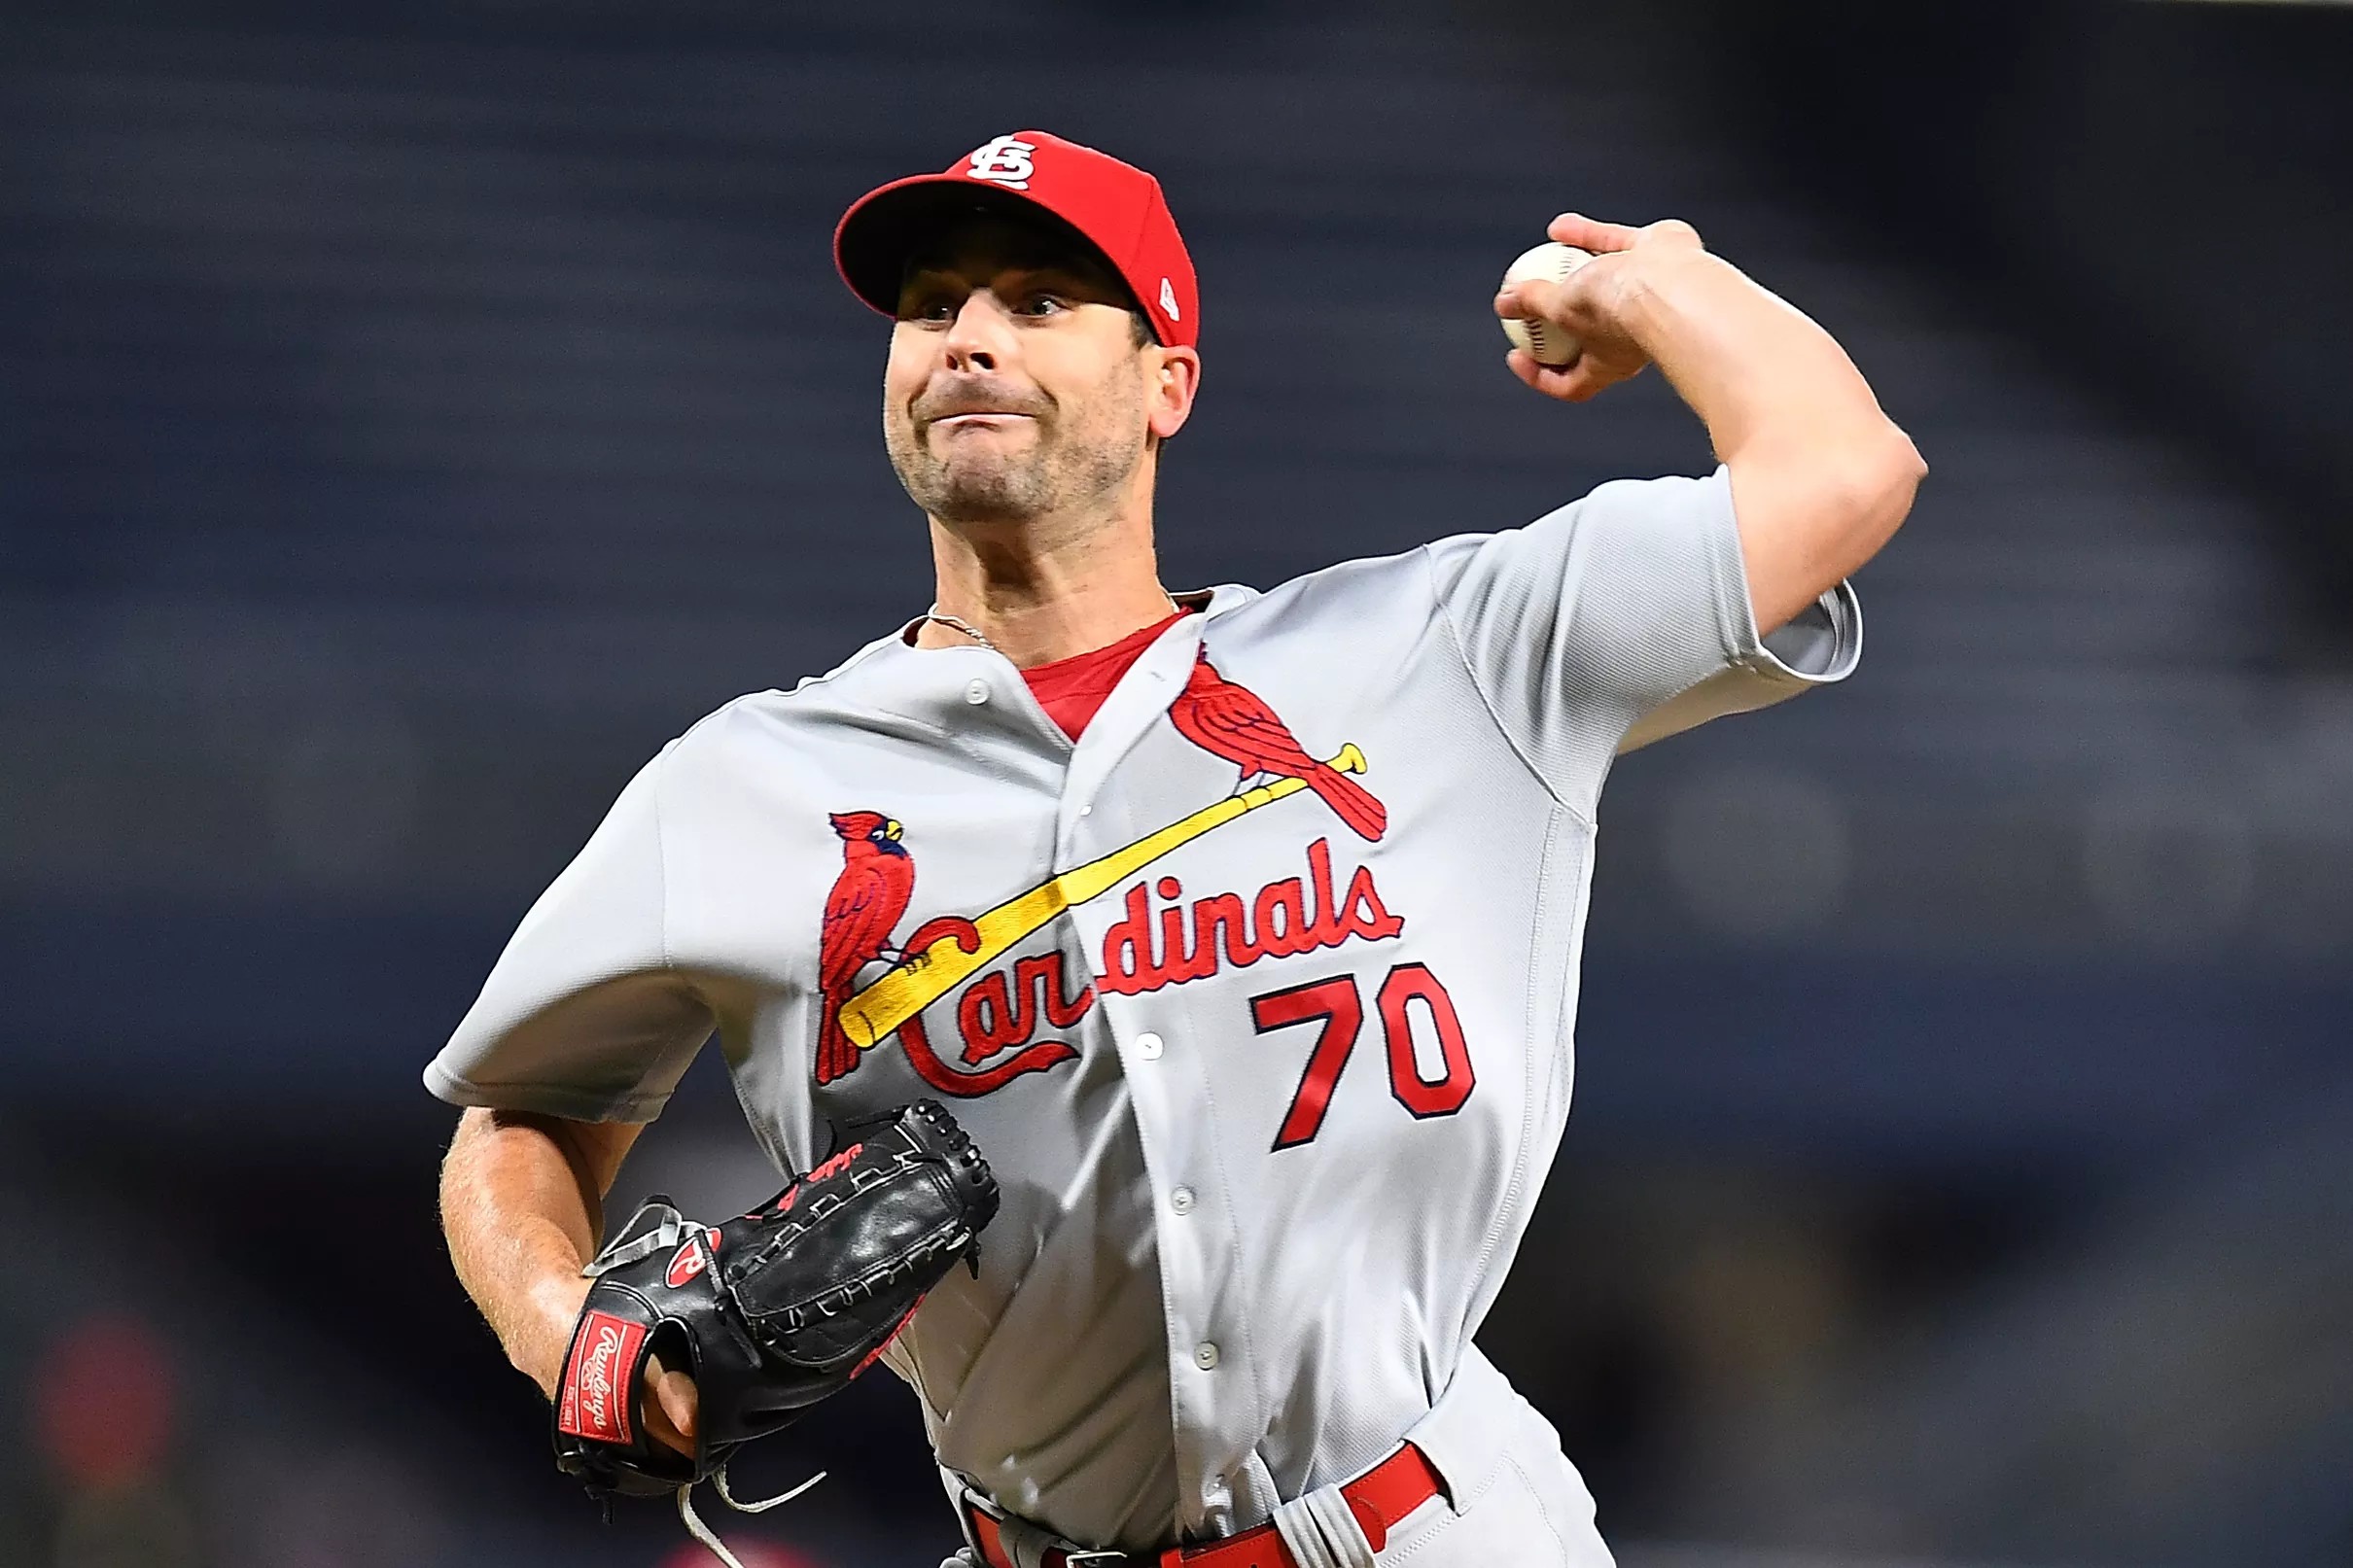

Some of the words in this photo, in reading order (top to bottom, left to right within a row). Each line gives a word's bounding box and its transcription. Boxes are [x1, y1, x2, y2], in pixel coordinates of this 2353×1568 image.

[896, 837, 1405, 1098] Cardinals
[1248, 961, 1477, 1154] 70
[583, 1325, 619, 1430] Rawlings
